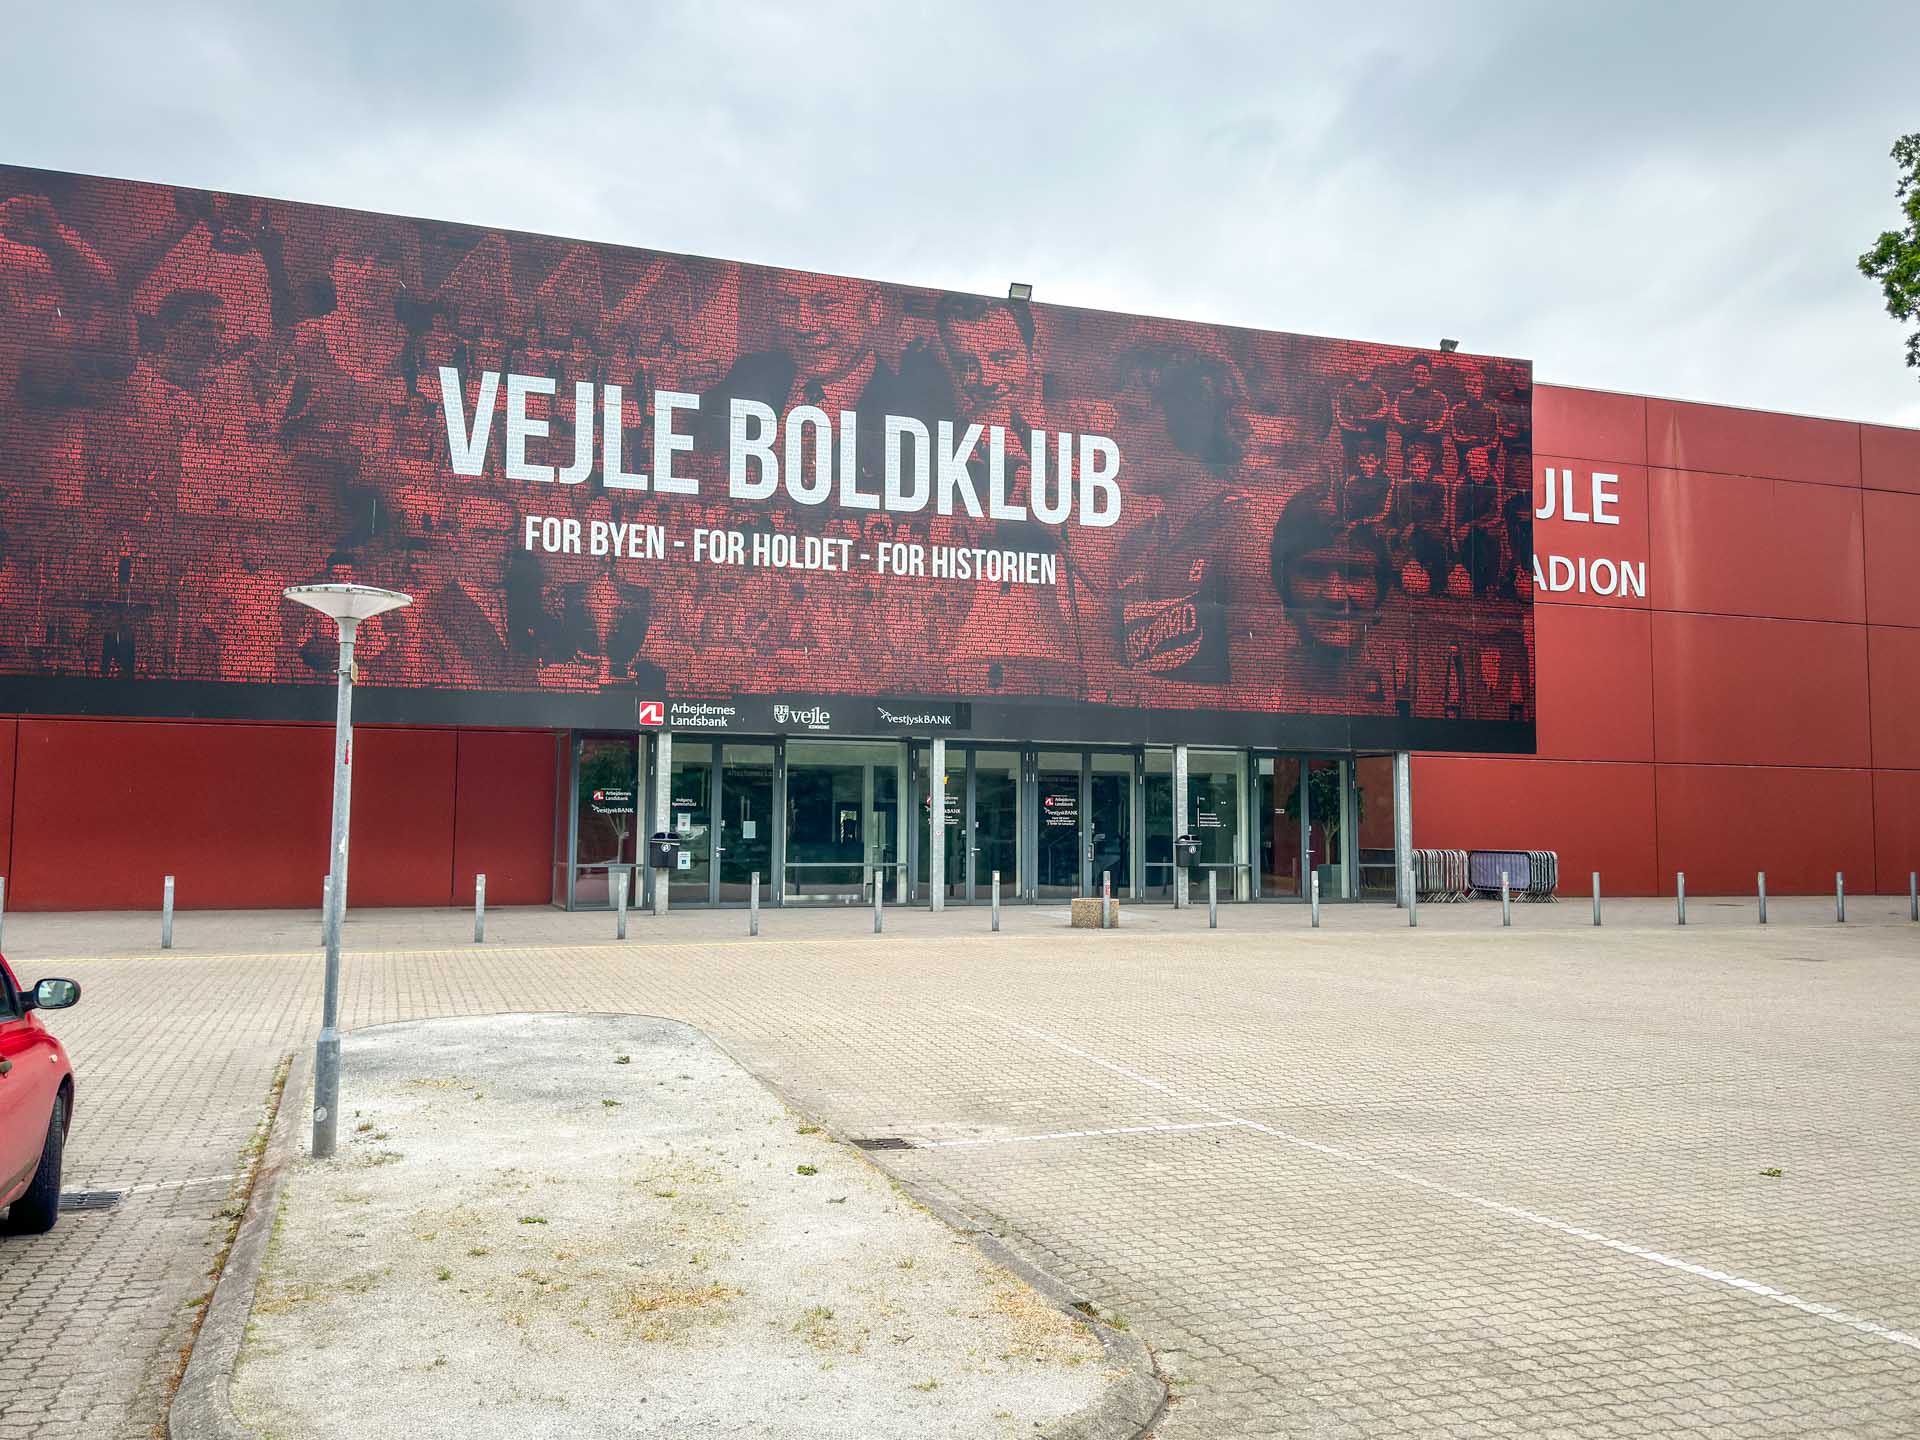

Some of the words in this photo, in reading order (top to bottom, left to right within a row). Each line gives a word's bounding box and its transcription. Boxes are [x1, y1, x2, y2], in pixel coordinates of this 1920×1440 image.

[439, 366, 700, 495] VEJLE
[729, 398, 1124, 529] BOLDKLUB
[1536, 468, 1619, 524] JLE
[525, 516, 581, 554] FOR
[590, 520, 664, 559] BYEN
[694, 528, 745, 565] FOR
[753, 532, 856, 572] HOLDET
[877, 541, 925, 576] FOR
[932, 544, 1058, 585] HISTORIEN
[671, 703, 736, 717] Arbejdernes
[790, 707, 831, 725] vejle
[671, 715, 728, 727] Landsbank
[887, 714, 952, 726] vestjyskBANK
